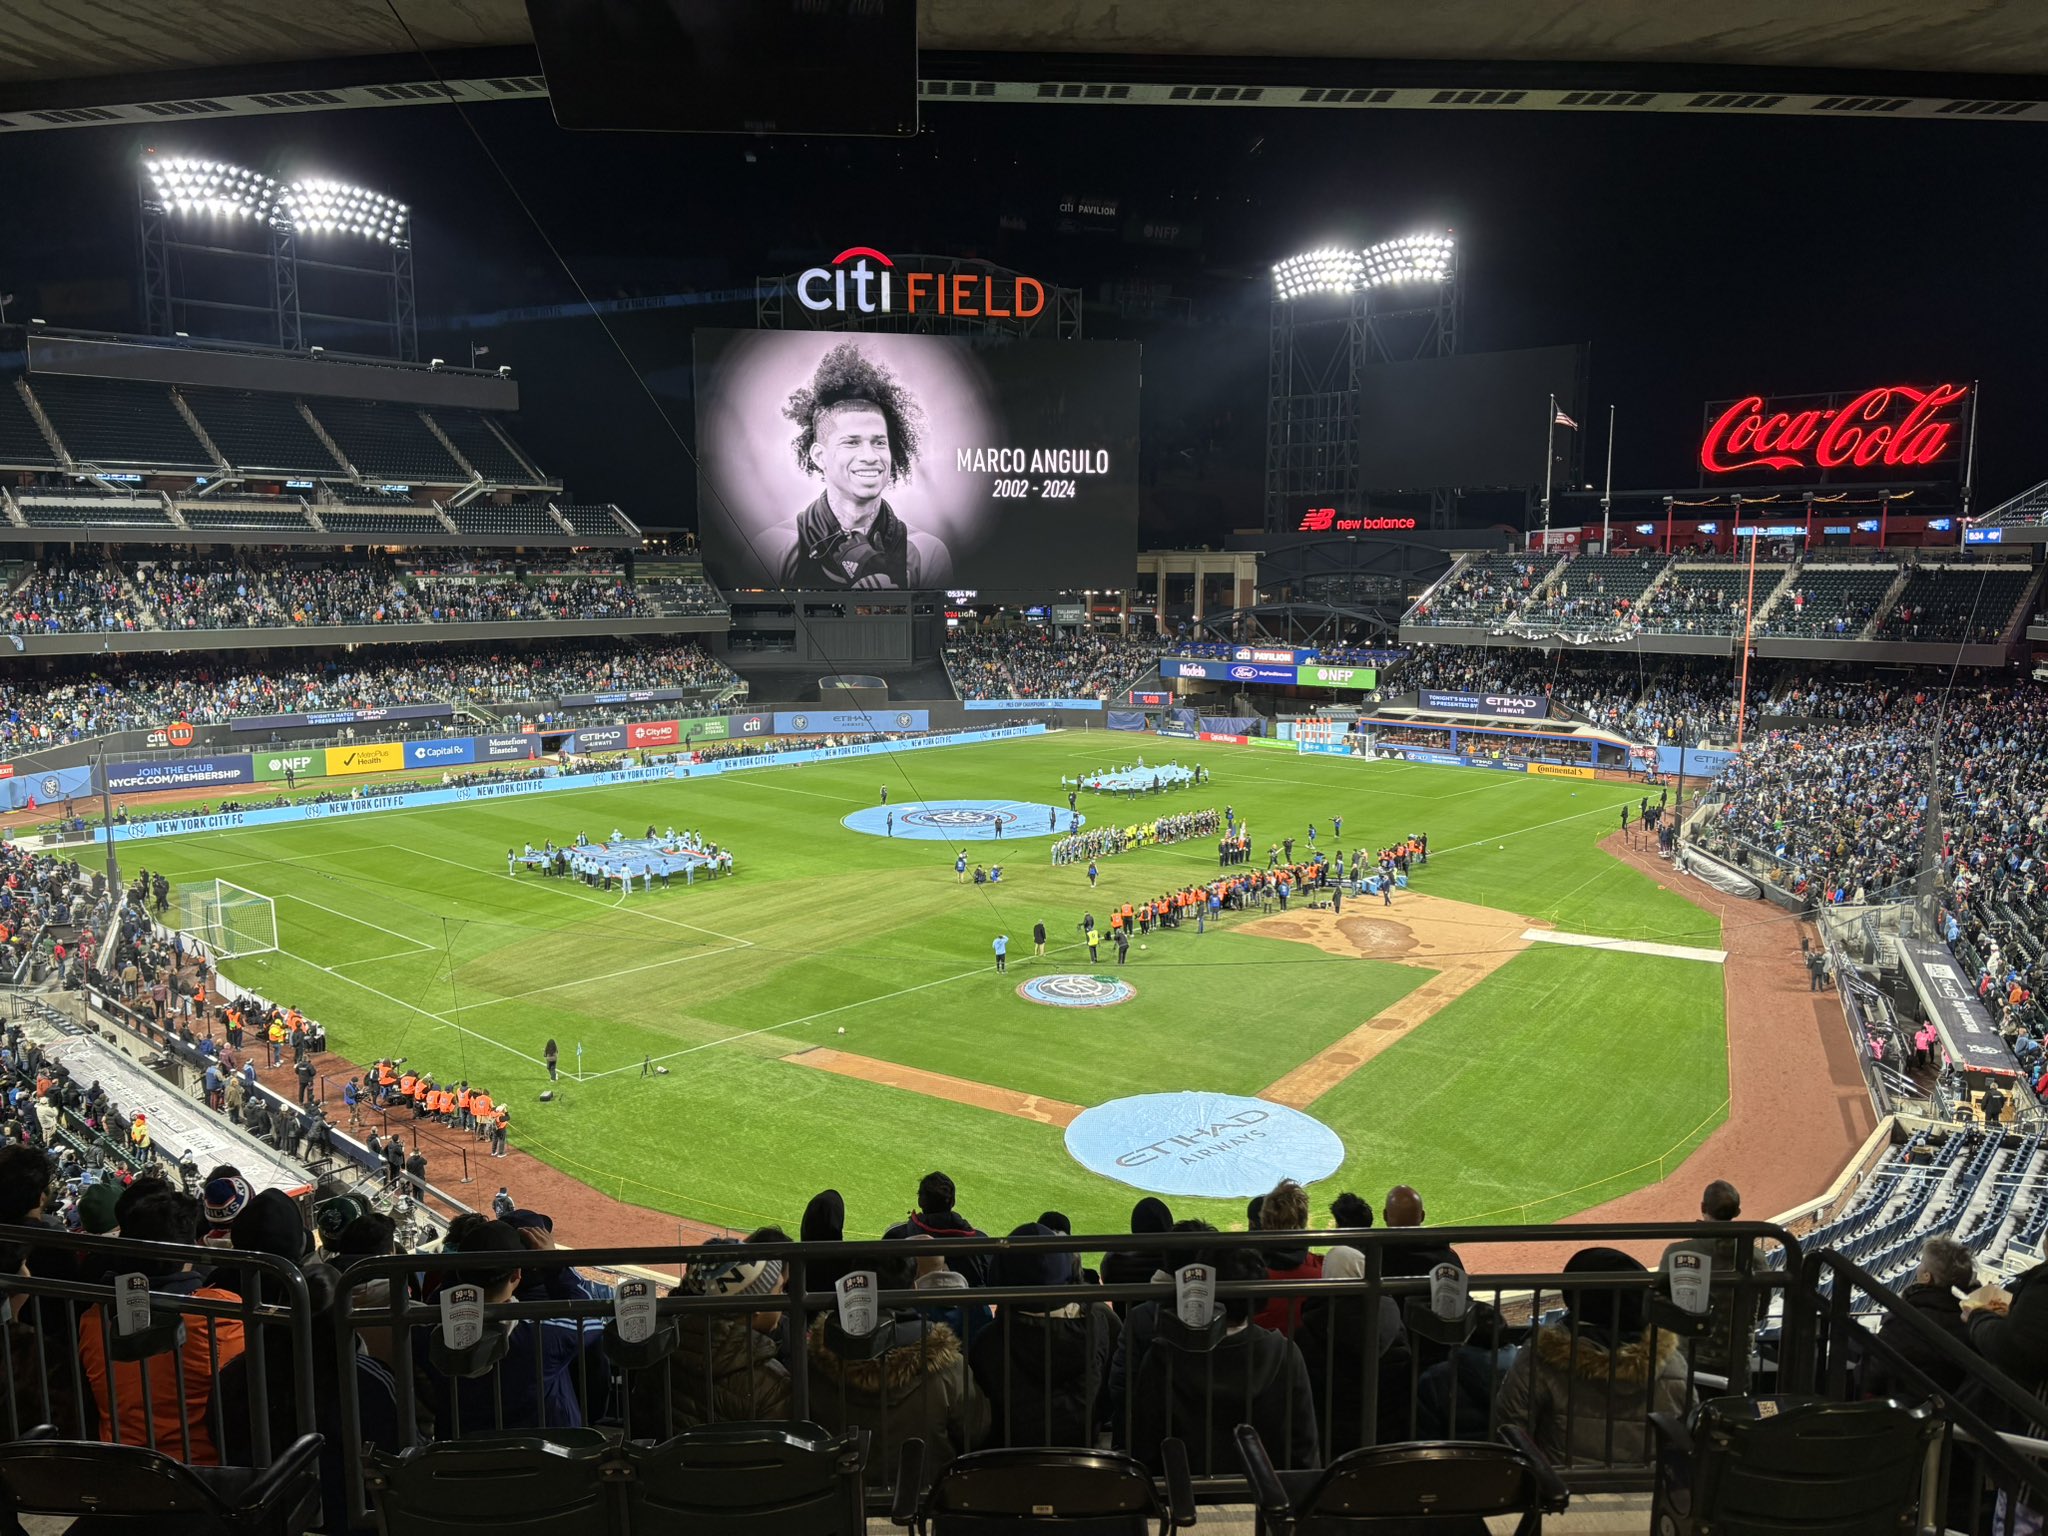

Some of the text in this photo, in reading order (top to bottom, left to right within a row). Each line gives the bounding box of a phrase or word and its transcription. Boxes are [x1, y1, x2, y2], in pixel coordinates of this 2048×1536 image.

[797, 249, 1045, 317] citi FIELD
[1701, 384, 1967, 472] Coca-Cola
[957, 448, 1108, 474] MARCO ANGULO
[992, 479, 1029, 497] 2002
[1041, 480, 1076, 498] 2024
[1337, 520, 1361, 530] new
[1363, 517, 1415, 530] balance
[1254, 652, 1291, 662] PAVILION
[1180, 664, 1206, 677] Modelo
[1235, 667, 1254, 677] Ford
[1328, 669, 1353, 682] NFP
[1459, 696, 1479, 704] MATCH
[1486, 697, 1536, 708] ETIHAD
[356, 709, 387, 717] ETIHAD
[1496, 707, 1525, 715] AIRWAYS
[743, 717, 760, 732] citi
[147, 729, 189, 743] citi 111
[489, 737, 528, 746] Montefiore
[580, 731, 621, 742] ETIHAD
[357, 750, 389, 759] MetroPlus
[427, 746, 464, 758] Capital Rx
[489, 746, 518, 754] Einstein
[282, 757, 311, 770] NFP
[358, 757, 382, 766] Health
[725, 756, 775, 768] NEW YORK CITY FC
[136, 763, 214, 778] JOIN THE CLUB
[611, 767, 669, 782] NEW YORK CITY FC
[1538, 765, 1577, 776] Continental
[109, 770, 240, 788] NYCFC.COM/MEMBERSHIP
[477, 781, 543, 797] NEW YORK CITY FC
[329, 796, 404, 814] NEW YORK CITY FC
[156, 814, 244, 834] NEW YORK CITY FC
[1115, 1109, 1270, 1168] ETIHAD
[1179, 1129, 1267, 1166] AIRWAYS
